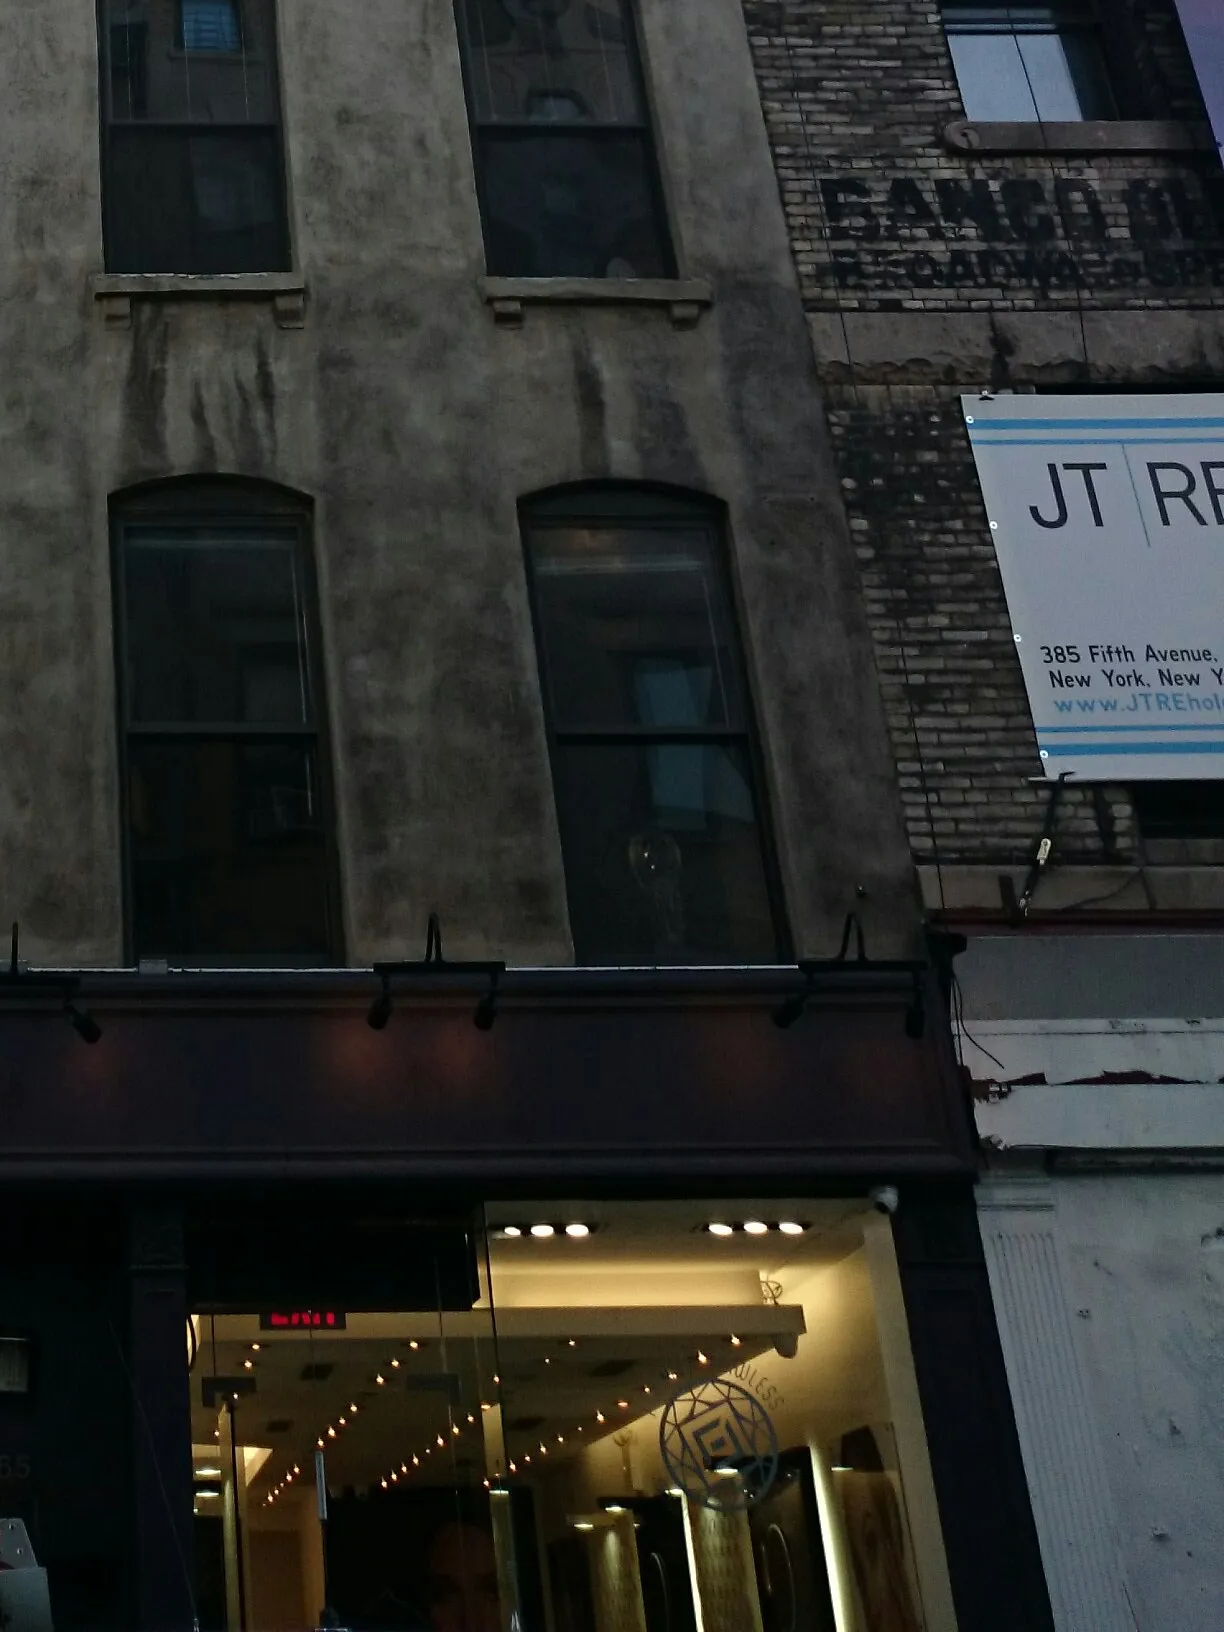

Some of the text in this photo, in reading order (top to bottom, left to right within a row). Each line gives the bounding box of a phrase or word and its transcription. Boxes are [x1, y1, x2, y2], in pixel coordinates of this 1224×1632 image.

[1028, 461, 1108, 529] JT
[1039, 644, 1081, 664] 385
[1088, 644, 1135, 664] Fifth
[1048, 669, 1092, 689] New
[1158, 667, 1201, 687] New
[1053, 692, 1224, 715] www.JTREhol
